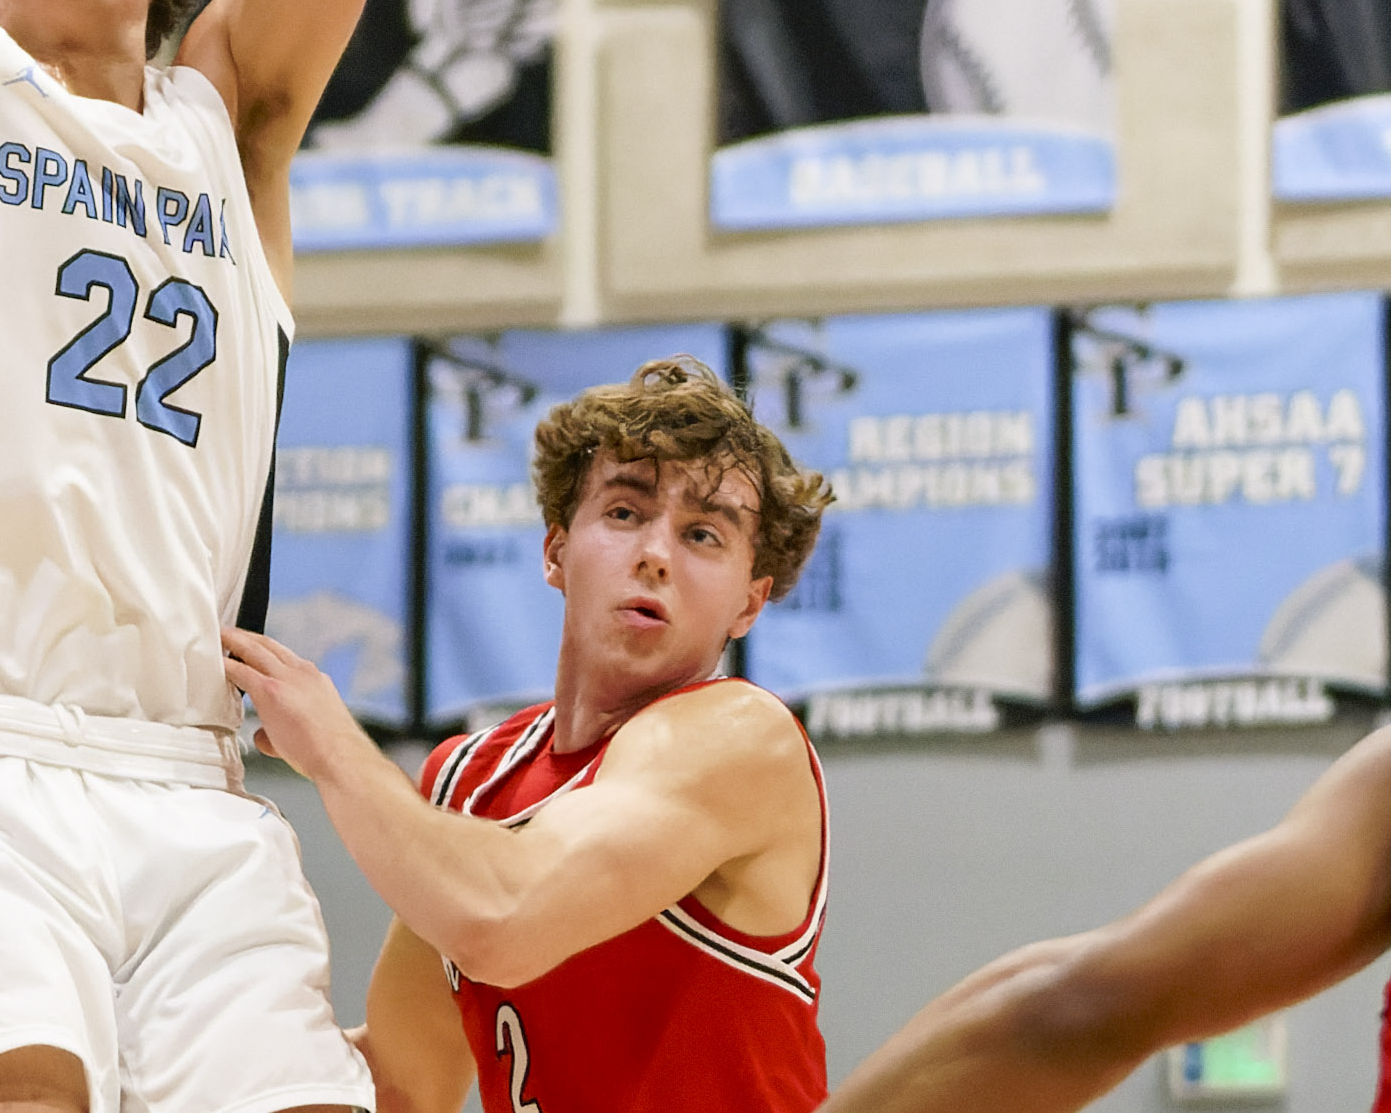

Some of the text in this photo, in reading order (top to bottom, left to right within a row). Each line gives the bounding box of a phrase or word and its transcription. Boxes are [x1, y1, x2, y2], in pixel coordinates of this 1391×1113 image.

[45, 247, 219, 449] 22
[1171, 388, 1366, 448] AHSAA
[1134, 443, 1367, 509] SUPER 7
